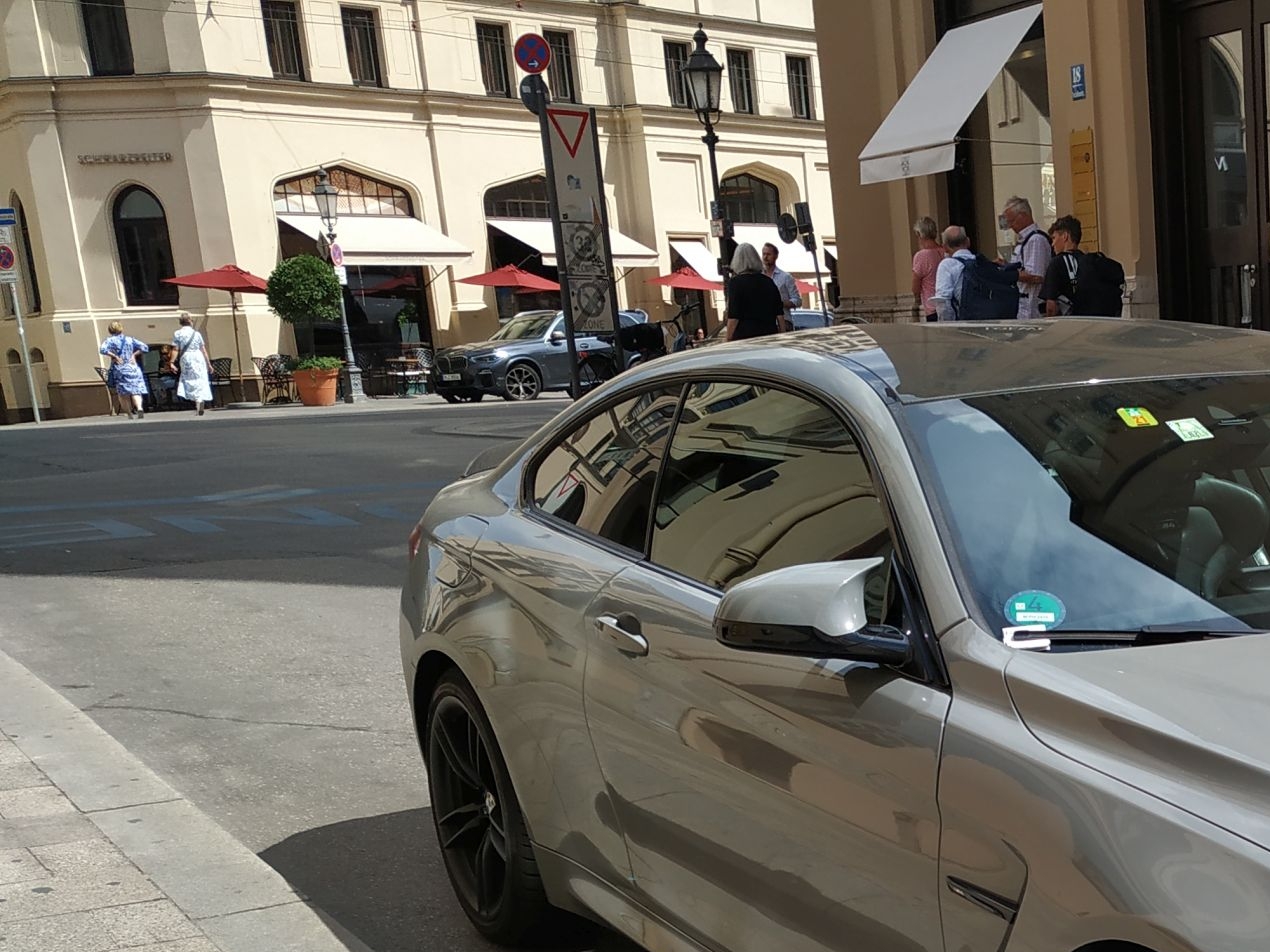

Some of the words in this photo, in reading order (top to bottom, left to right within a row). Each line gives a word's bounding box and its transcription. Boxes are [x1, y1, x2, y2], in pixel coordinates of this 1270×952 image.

[1072, 66, 1082, 83] 18
[583, 319, 605, 330] ZONE
[1027, 595, 1042, 612] 4
